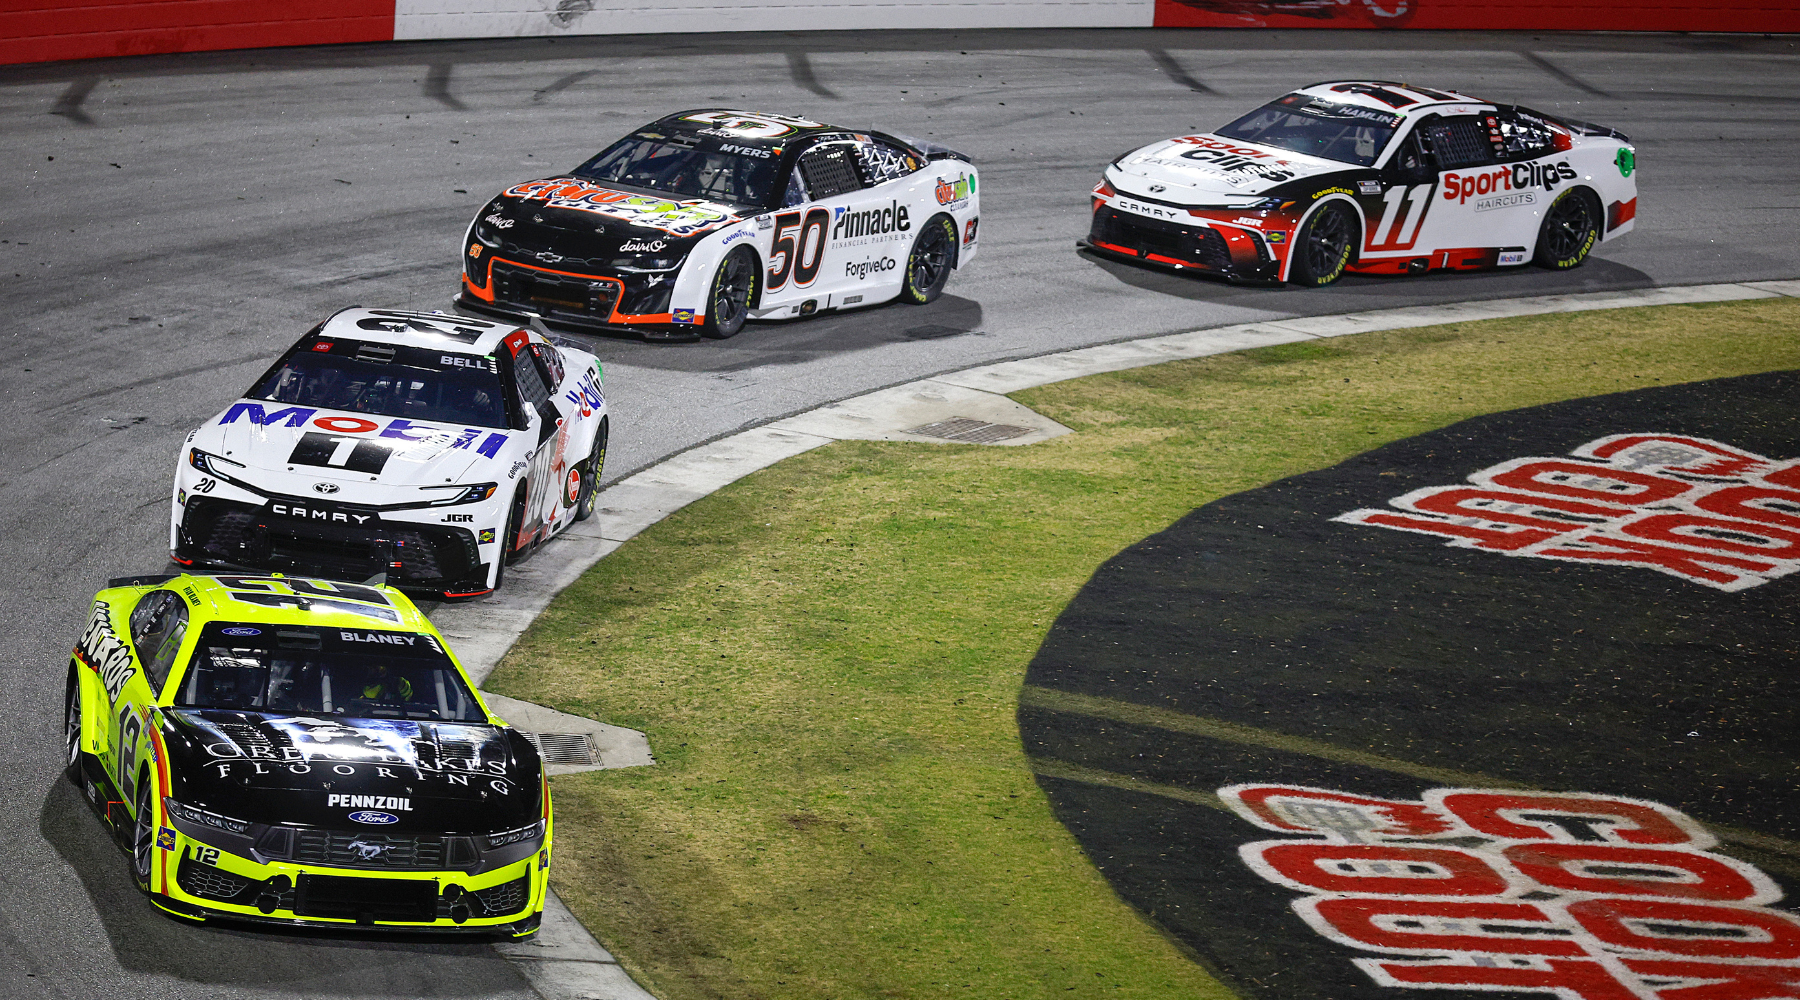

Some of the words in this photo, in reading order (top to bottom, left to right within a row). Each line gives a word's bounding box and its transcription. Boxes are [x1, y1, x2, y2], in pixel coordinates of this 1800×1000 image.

[1338, 106, 1395, 124] HAMLIN
[719, 143, 772, 159] MYERS
[1311, 186, 1354, 200] GOODYEAR
[1119, 200, 1178, 219] CAMRY
[1476, 194, 1534, 211] HAIRCUTS
[833, 200, 911, 240] Pinnacle
[1232, 217, 1263, 227] JGR
[1371, 183, 1433, 246] 11
[721, 229, 756, 245] GOODYEAR
[832, 239, 869, 250] FINANCIAL
[872, 232, 914, 244] PARTNERS
[767, 207, 830, 289] 50
[845, 255, 896, 281] ForgiveCo
[440, 355, 488, 370] BELL
[193, 477, 216, 494] 20
[272, 504, 371, 525] CAMRY
[440, 514, 474, 523] JGR
[341, 631, 417, 646] BLANEY
[119, 701, 141, 810] 12
[327, 793, 414, 812] PENNZOIL
[195, 845, 221, 866] 12
